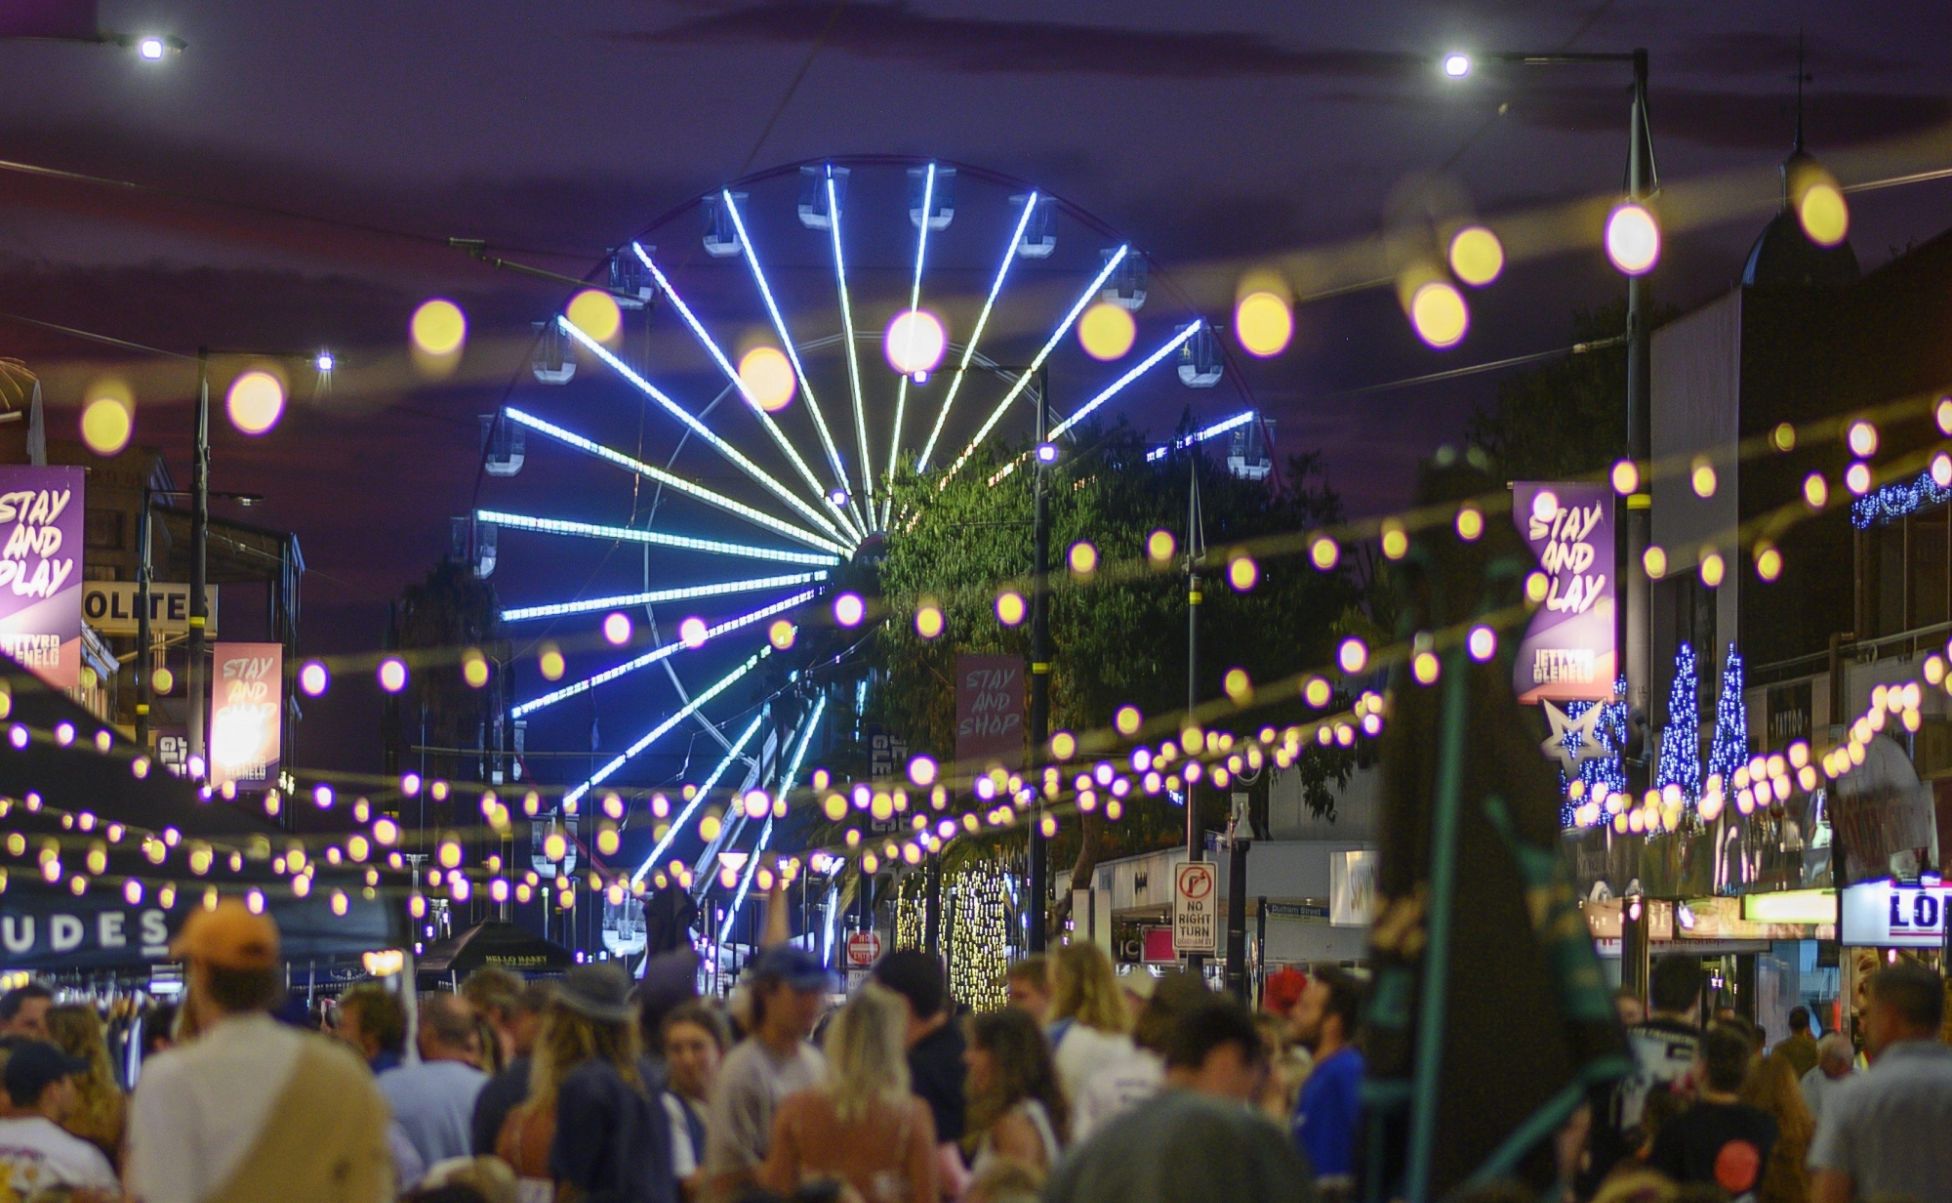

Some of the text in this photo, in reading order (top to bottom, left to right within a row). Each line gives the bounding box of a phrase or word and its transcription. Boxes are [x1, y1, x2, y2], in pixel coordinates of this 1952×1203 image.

[0, 490, 71, 526] STAY
[1529, 503, 1602, 541] STAY
[3, 522, 62, 560] AND
[1541, 541, 1595, 574] AND
[84, 590, 209, 620] OLITE
[1546, 575, 1606, 613] LAY
[224, 657, 274, 680] STAY
[966, 669, 1016, 690] STAY
[228, 680, 269, 704] AND
[972, 691, 1010, 714] AND
[959, 713, 1020, 736] SHOP
[1187, 901, 1203, 912] NO
[1889, 894, 1952, 928] LO
[1178, 914, 1211, 925] RIGHT
[1180, 926, 1209, 937] TURN
